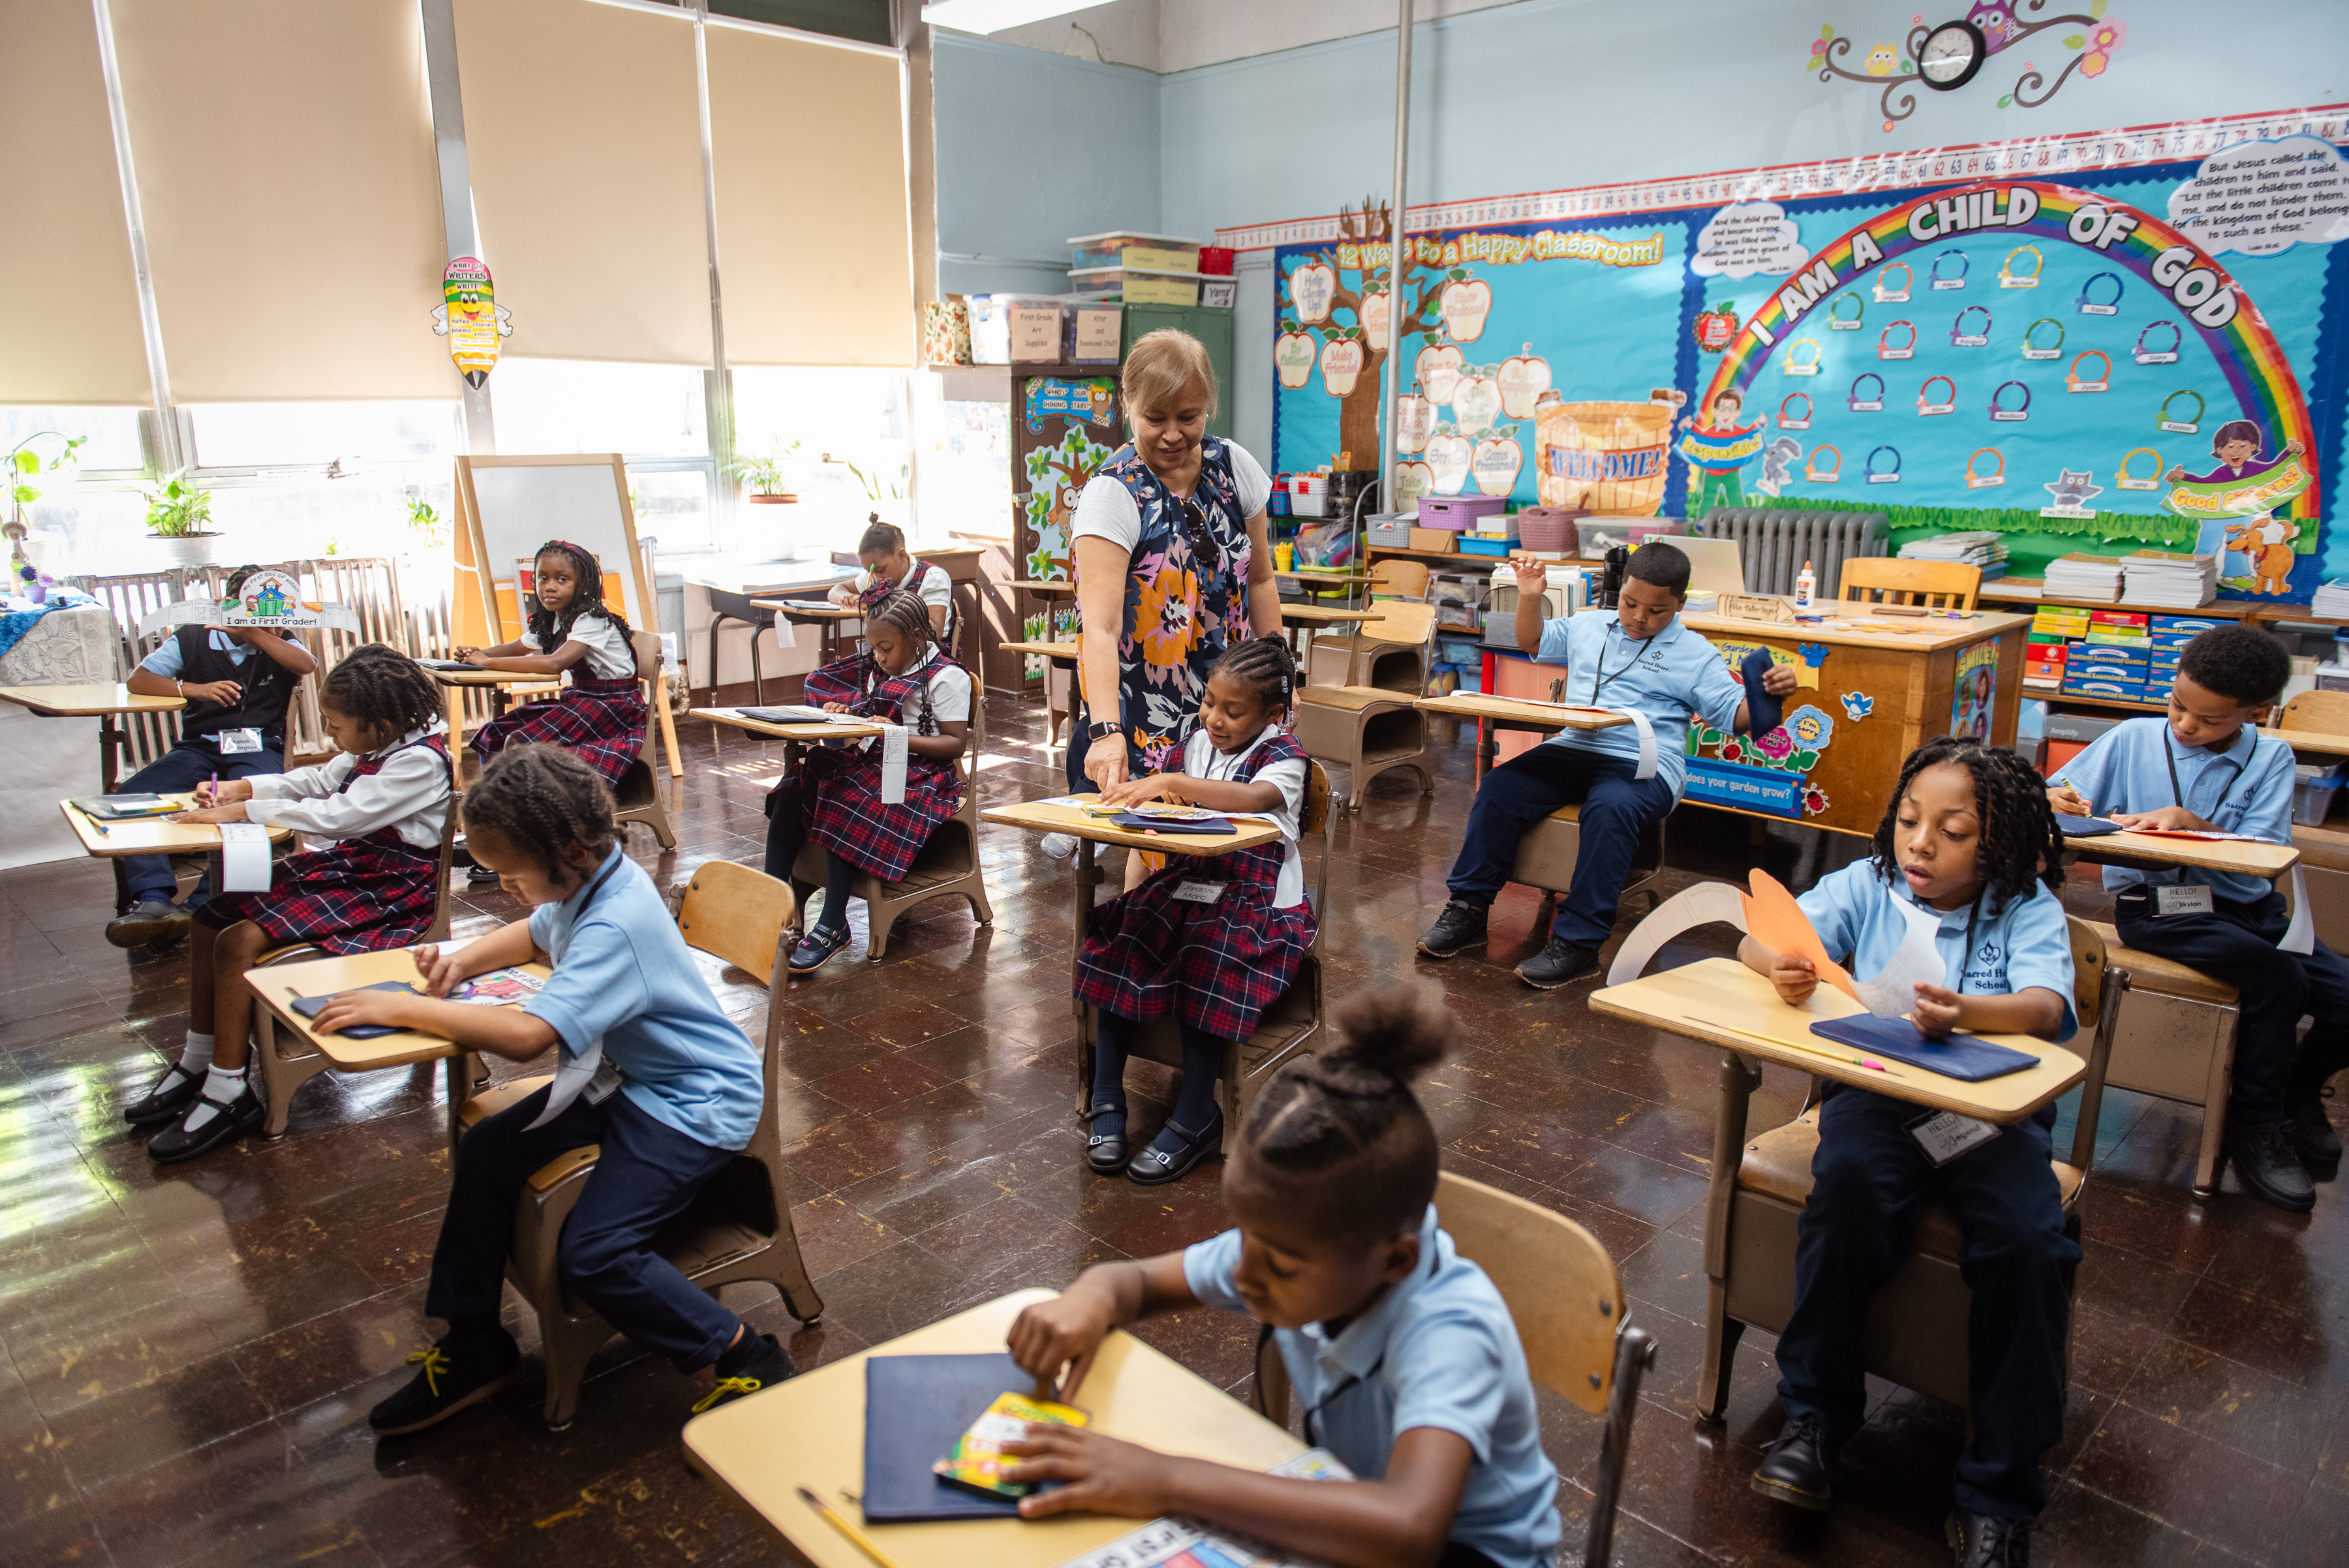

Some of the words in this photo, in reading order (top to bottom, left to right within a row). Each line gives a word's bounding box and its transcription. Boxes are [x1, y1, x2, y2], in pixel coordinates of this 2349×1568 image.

[1535, 203, 1541, 214] 33
[1605, 196, 1614, 208] 39
[1710, 185, 1717, 197] 47
[1779, 178, 1788, 191] 52
[1824, 173, 1833, 187] 55
[1919, 164, 1927, 177] 61
[1951, 161, 1961, 174] 63
[1985, 157, 1996, 171] 65
[2038, 152, 2050, 166] 68
[2114, 144, 2125, 159] 72
[2213, 132, 2227, 149] 77
[2322, 121, 2336, 138] 82
[2210, 164, 2229, 173] But
[2234, 160, 2266, 170] Jesus
[2271, 153, 2303, 165] called
[2309, 150, 2327, 159] the
[2195, 175, 2237, 187] children
[2258, 170, 2280, 180] him
[2285, 167, 2307, 177] and
[2207, 189, 2223, 199] the
[2228, 186, 2253, 196] little
[2258, 181, 2302, 193] children
[2308, 179, 2337, 188] come
[2206, 202, 2226, 212] and
[2231, 201, 2244, 210] do
[2249, 199, 2267, 208] not
[2271, 194, 2309, 206] hinder
[1763, 215, 1780, 224] grew
[2192, 218, 2209, 228] the
[2213, 213, 2262, 226] kingdom
[2267, 211, 2279, 220] of
[2284, 208, 2305, 218] God
[2208, 231, 2218, 239] to
[2224, 228, 2249, 238] such
[1338, 245, 1357, 265] 12
[1417, 238, 1441, 260] to
[1445, 245, 1457, 261] a
[1462, 235, 1530, 261] Happy
[1535, 234, 1663, 264] Classroom!
[1762, 247, 1779, 256] grace
[1749, 319, 1775, 348] I
[1777, 258, 1840, 323] AM
[1850, 229, 1884, 271] A
[1907, 186, 2040, 241] CHILD
[2067, 202, 2140, 251] OF
[2150, 245, 2239, 330] GOD
[1305, 275, 1324, 288] Help
[1303, 288, 1327, 299] Clean
[1308, 299, 1322, 314] Up!
[1291, 343, 1302, 354] Be
[1280, 354, 1310, 366] Patient!
[1332, 350, 1353, 361] Make
[1325, 361, 1358, 374] Friends!
[1422, 361, 1443, 371] Love
[1446, 360, 1458, 369] to
[1472, 386, 1484, 397] Do
[1682, 435, 1762, 459] Responsible!
[1430, 449, 1468, 465] Smile!
[1484, 450, 1509, 461] Come
[1476, 457, 1517, 476] Prepared!
[1550, 449, 1661, 480] WELCOME!
[1401, 476, 1422, 487] Take
[2173, 489, 2219, 510] Good
[2223, 465, 2301, 510] Citizens!
[1398, 487, 1425, 499] Turns!
[251, 575, 262, 583] first
[286, 579, 300, 592] school
[1638, 658, 1654, 668] Sacred
[1654, 662, 1668, 672] Heart
[1959, 646, 1996, 677] SMILE!
[1642, 666, 1659, 674] School
[1804, 720, 1817, 729] I'm
[1796, 725, 1819, 738] Sorry
[1687, 773, 1705, 784] does
[1708, 778, 1727, 788] your
[1730, 781, 1760, 794] garden
[1762, 788, 1791, 799] grow?
[1184, 885, 1215, 893] Jiyanni
[1961, 969, 1992, 978] Sacred
[1976, 981, 2006, 989] School
[1927, 1115, 1959, 1135] HELLO!
